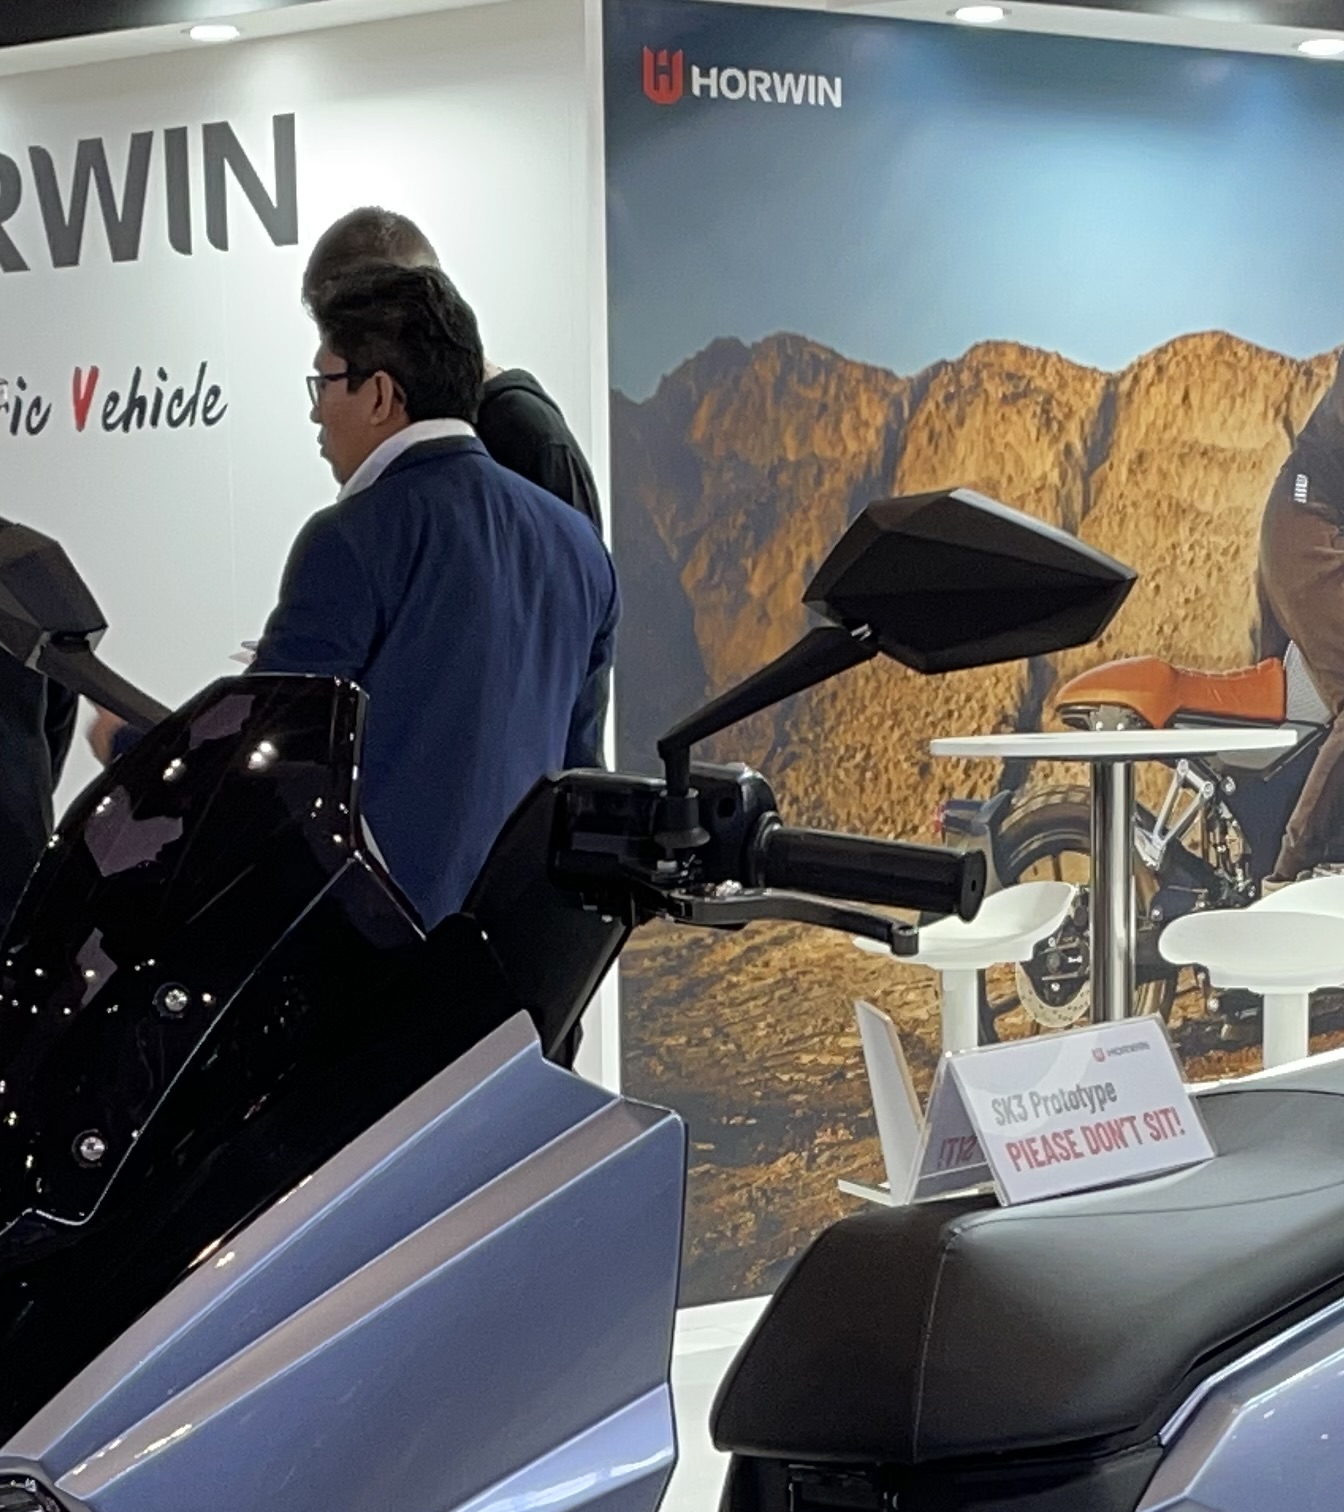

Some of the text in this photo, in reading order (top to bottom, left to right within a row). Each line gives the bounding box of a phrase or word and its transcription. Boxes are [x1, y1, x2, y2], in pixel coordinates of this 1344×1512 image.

[691, 64, 842, 108] HORWIN
[72, 361, 228, 432] Vehicle
[991, 1082, 1118, 1126] SK3 Prototype
[1005, 1106, 1186, 1172] PLEASE DON'T SIT!
